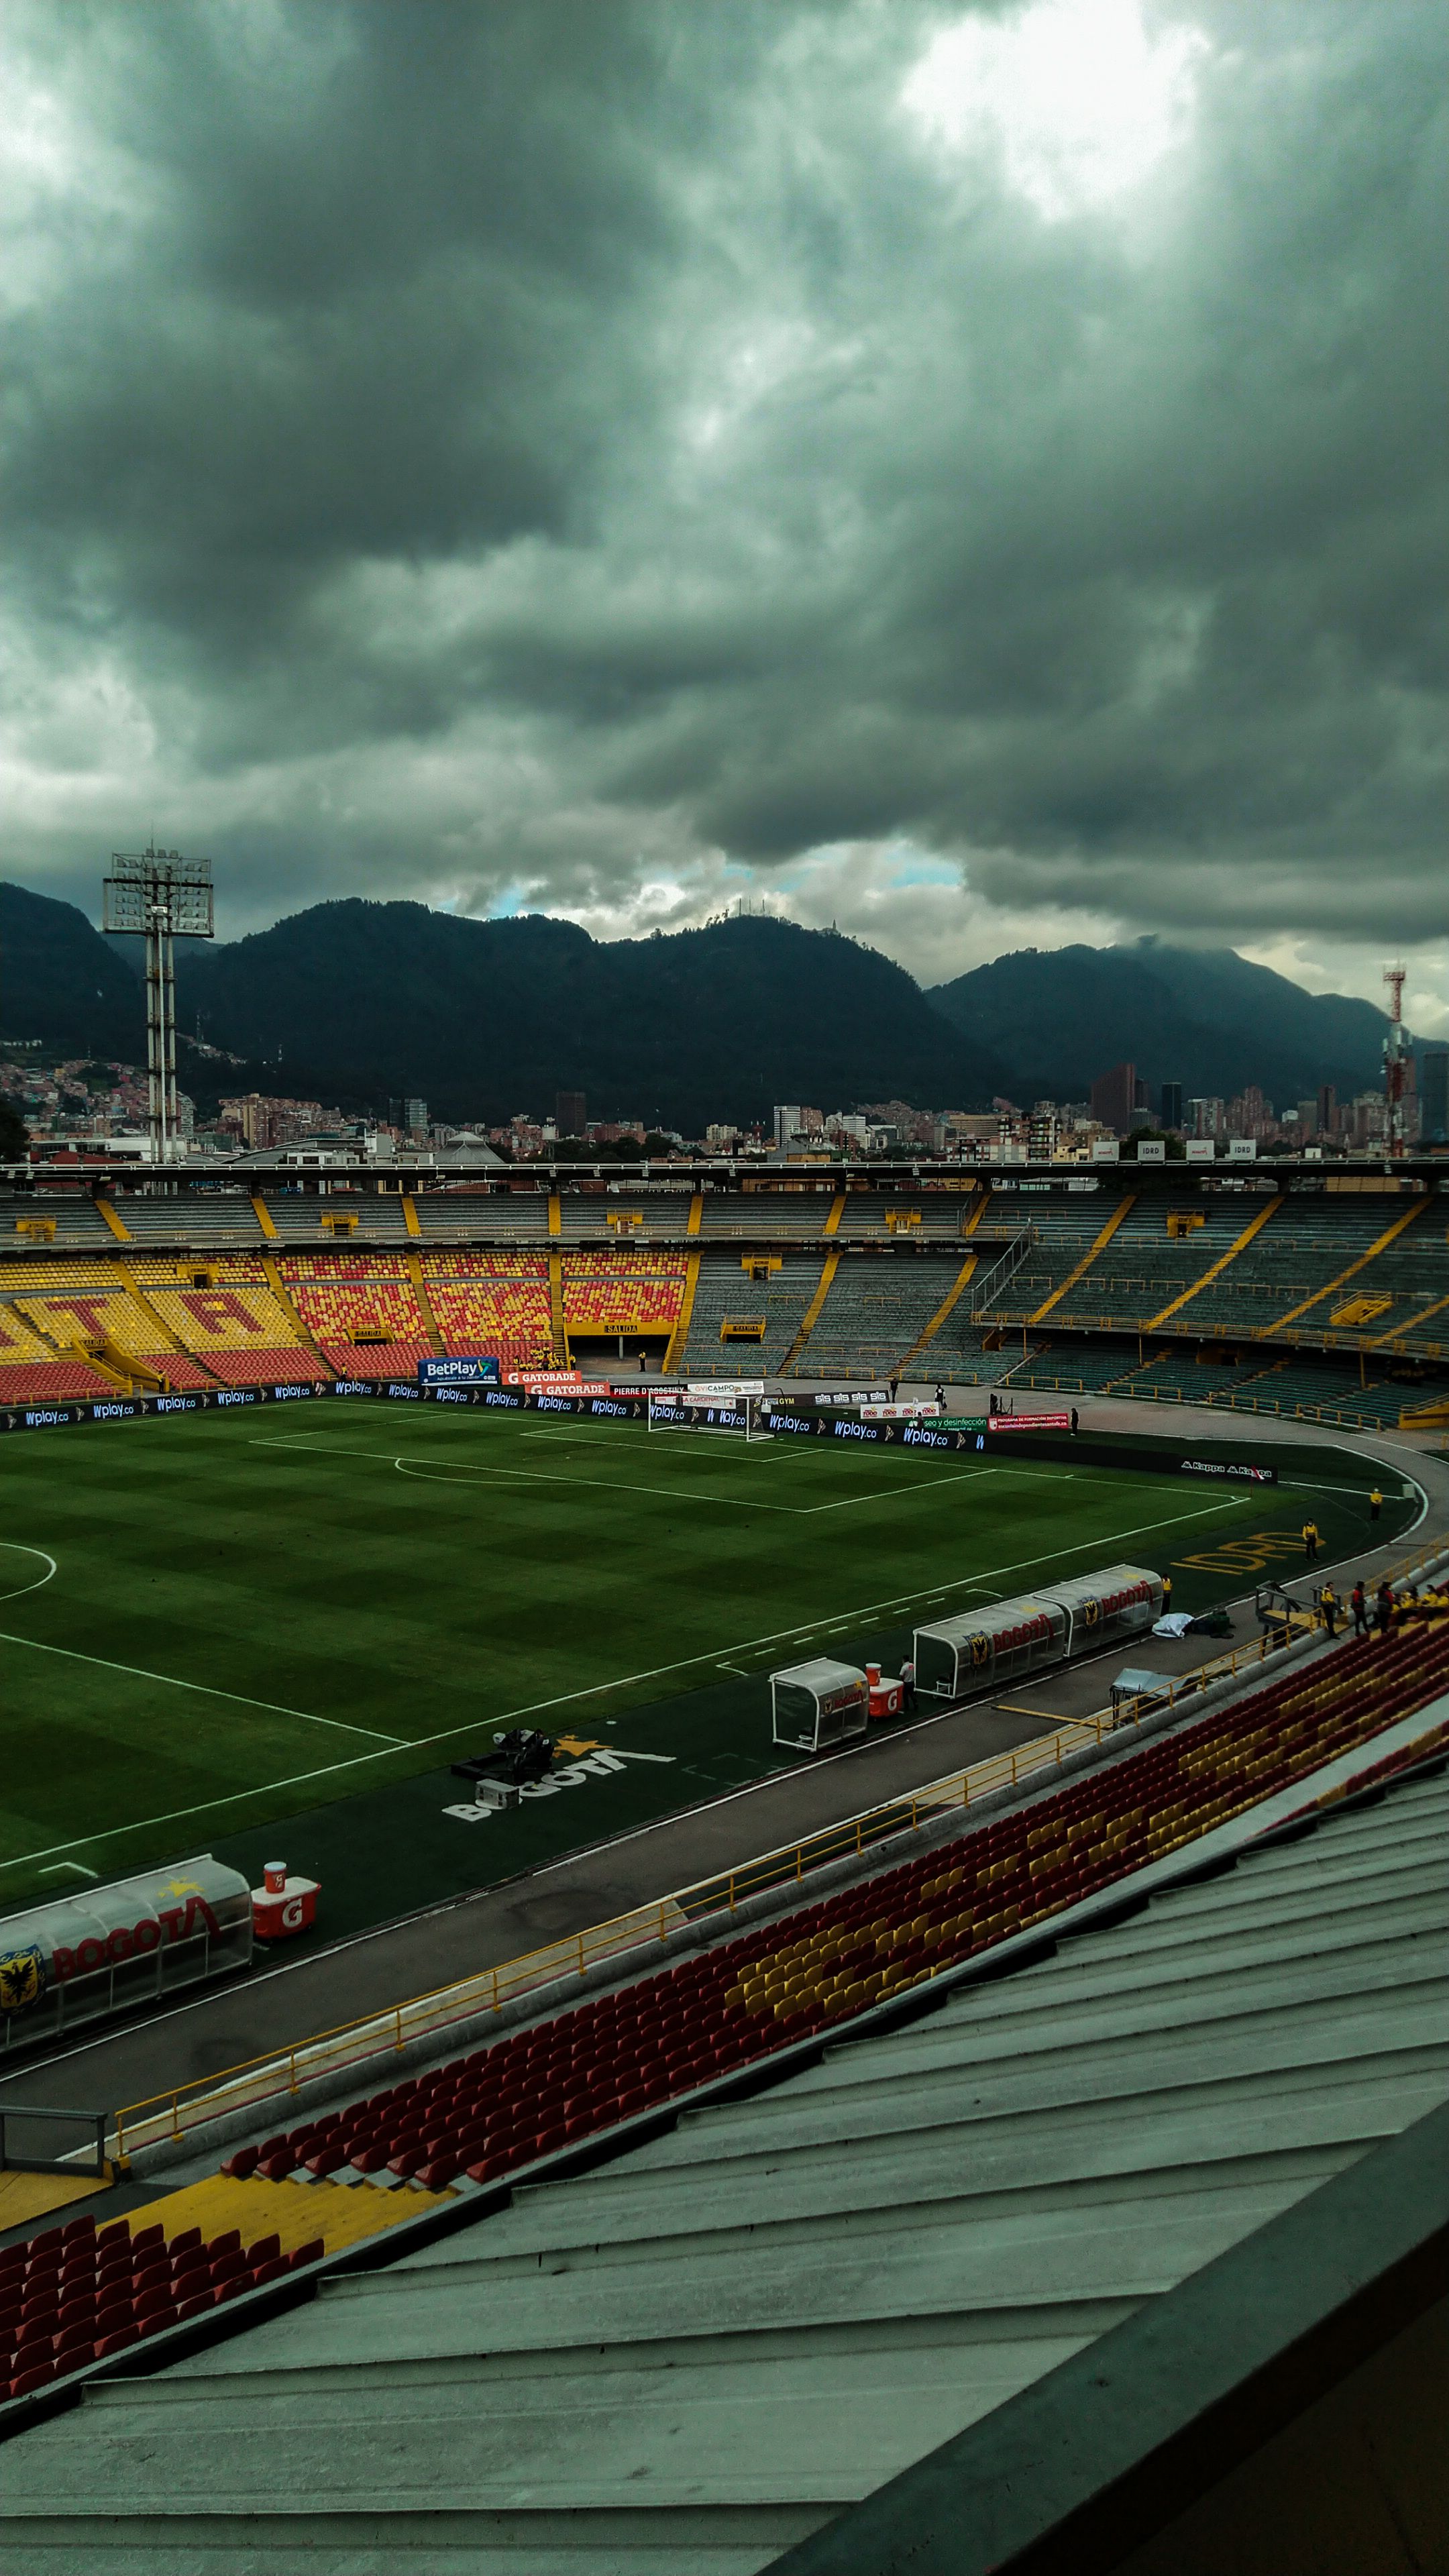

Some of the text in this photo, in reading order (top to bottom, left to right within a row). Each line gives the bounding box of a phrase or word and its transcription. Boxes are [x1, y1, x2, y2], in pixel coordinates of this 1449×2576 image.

[427, 1360, 477, 1376] BetPlay
[508, 1373, 576, 1384] G GATORADE
[275, 1385, 310, 1400] Wplay.co
[335, 1381, 372, 1395] Wplay.co
[388, 1384, 419, 1399] Wplay.co
[436, 1387, 468, 1403] Wplay.co
[546, 1385, 604, 1395] GATORADE
[614, 1387, 640, 1395] PIERRE
[157, 1396, 196, 1412] Wplay.co
[217, 1390, 254, 1406] Wplay.co
[486, 1391, 519, 1407] Wplay.co
[537, 1395, 572, 1411] Wplay.co
[93, 1402, 133, 1419] Wplay.co
[591, 1399, 627, 1416] Wplay.co
[649, 1404, 685, 1421] Wplay.co
[25, 1410, 68, 1427] Wplay.co
[769, 1414, 810, 1433] Wplay.co
[938, 1419, 943, 1428] y
[943, 1417, 987, 1426] desinfección
[835, 1420, 877, 1440] Wplay.co
[904, 1428, 948, 1447] Wplay.co
[1193, 1462, 1225, 1472] Kappa
[1238, 1466, 1272, 1477] Kapa
[282, 1898, 303, 1928] G
